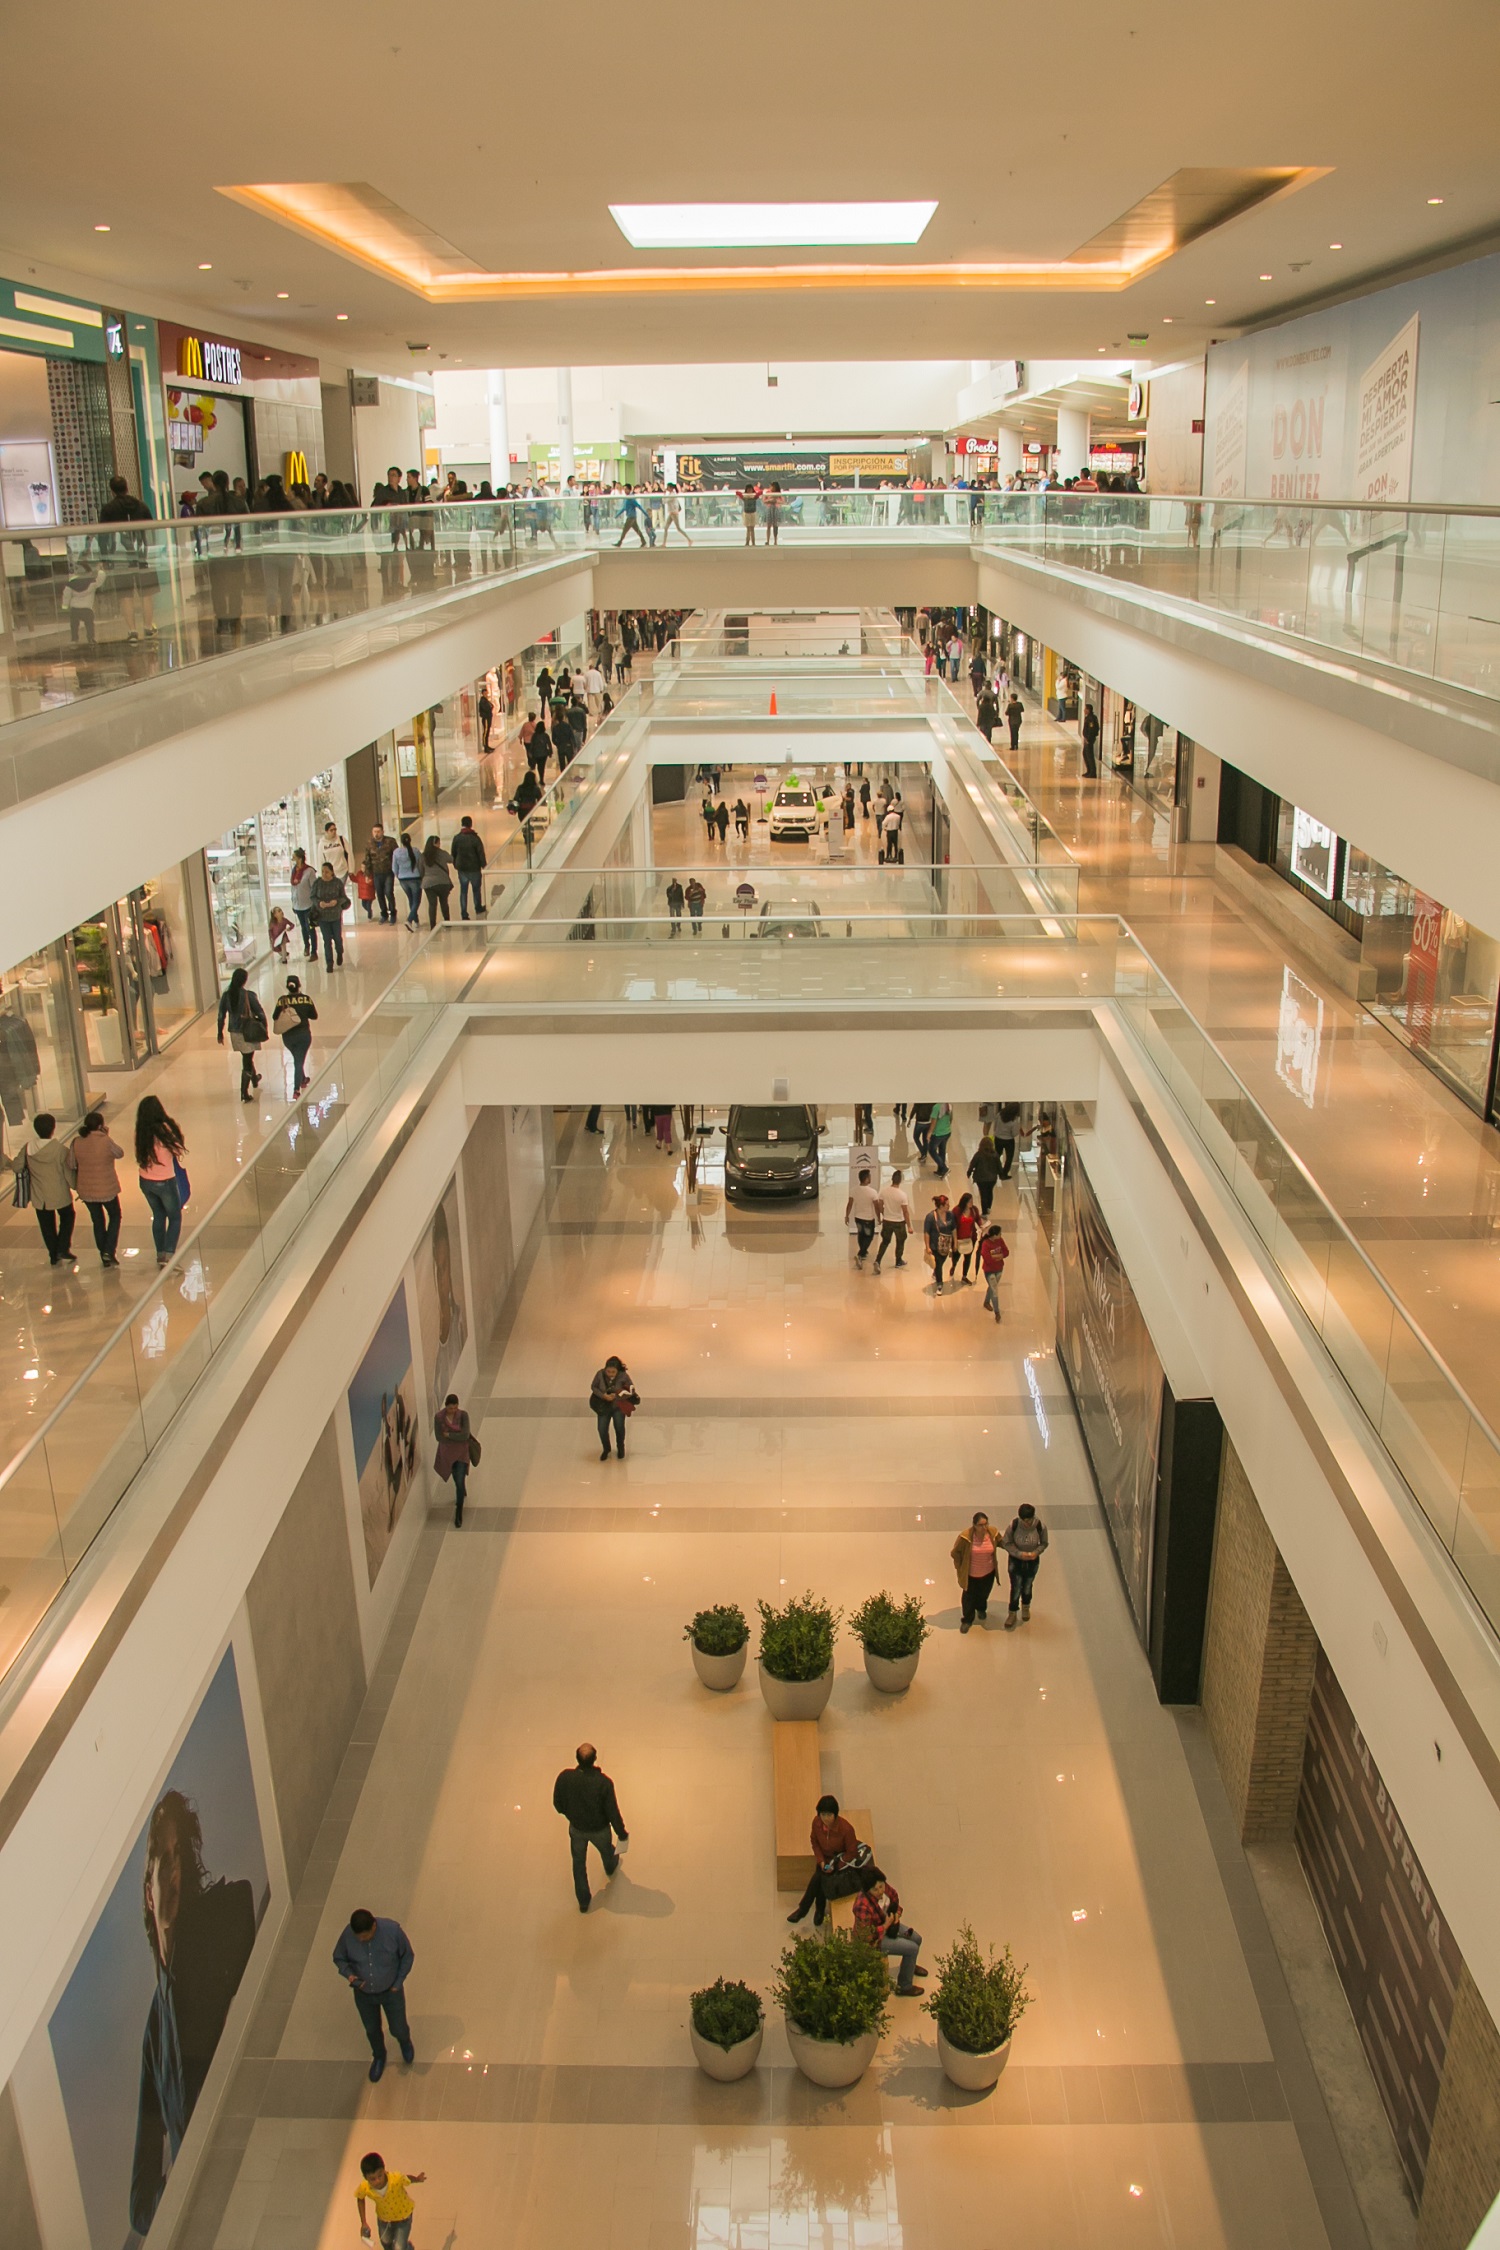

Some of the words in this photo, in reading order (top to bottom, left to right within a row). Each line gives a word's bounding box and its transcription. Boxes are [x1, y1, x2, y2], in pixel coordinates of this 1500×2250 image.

[204, 341, 242, 386] POSTRES
[1362, 349, 1409, 408] DESPIERTA
[1361, 400, 1372, 431] MI
[1375, 369, 1409, 418] AMOR
[1272, 394, 1325, 460] DON
[1360, 398, 1407, 449] DESPIERTA
[680, 455, 702, 474] fit
[744, 462, 826, 471] www.smartfit.com.co
[834, 456, 885, 465] INSCRIPCIÓN
[966, 438, 997, 454] Presto
[1367, 472, 1388, 500] DON
[1413, 908, 1438, 952] 60%
